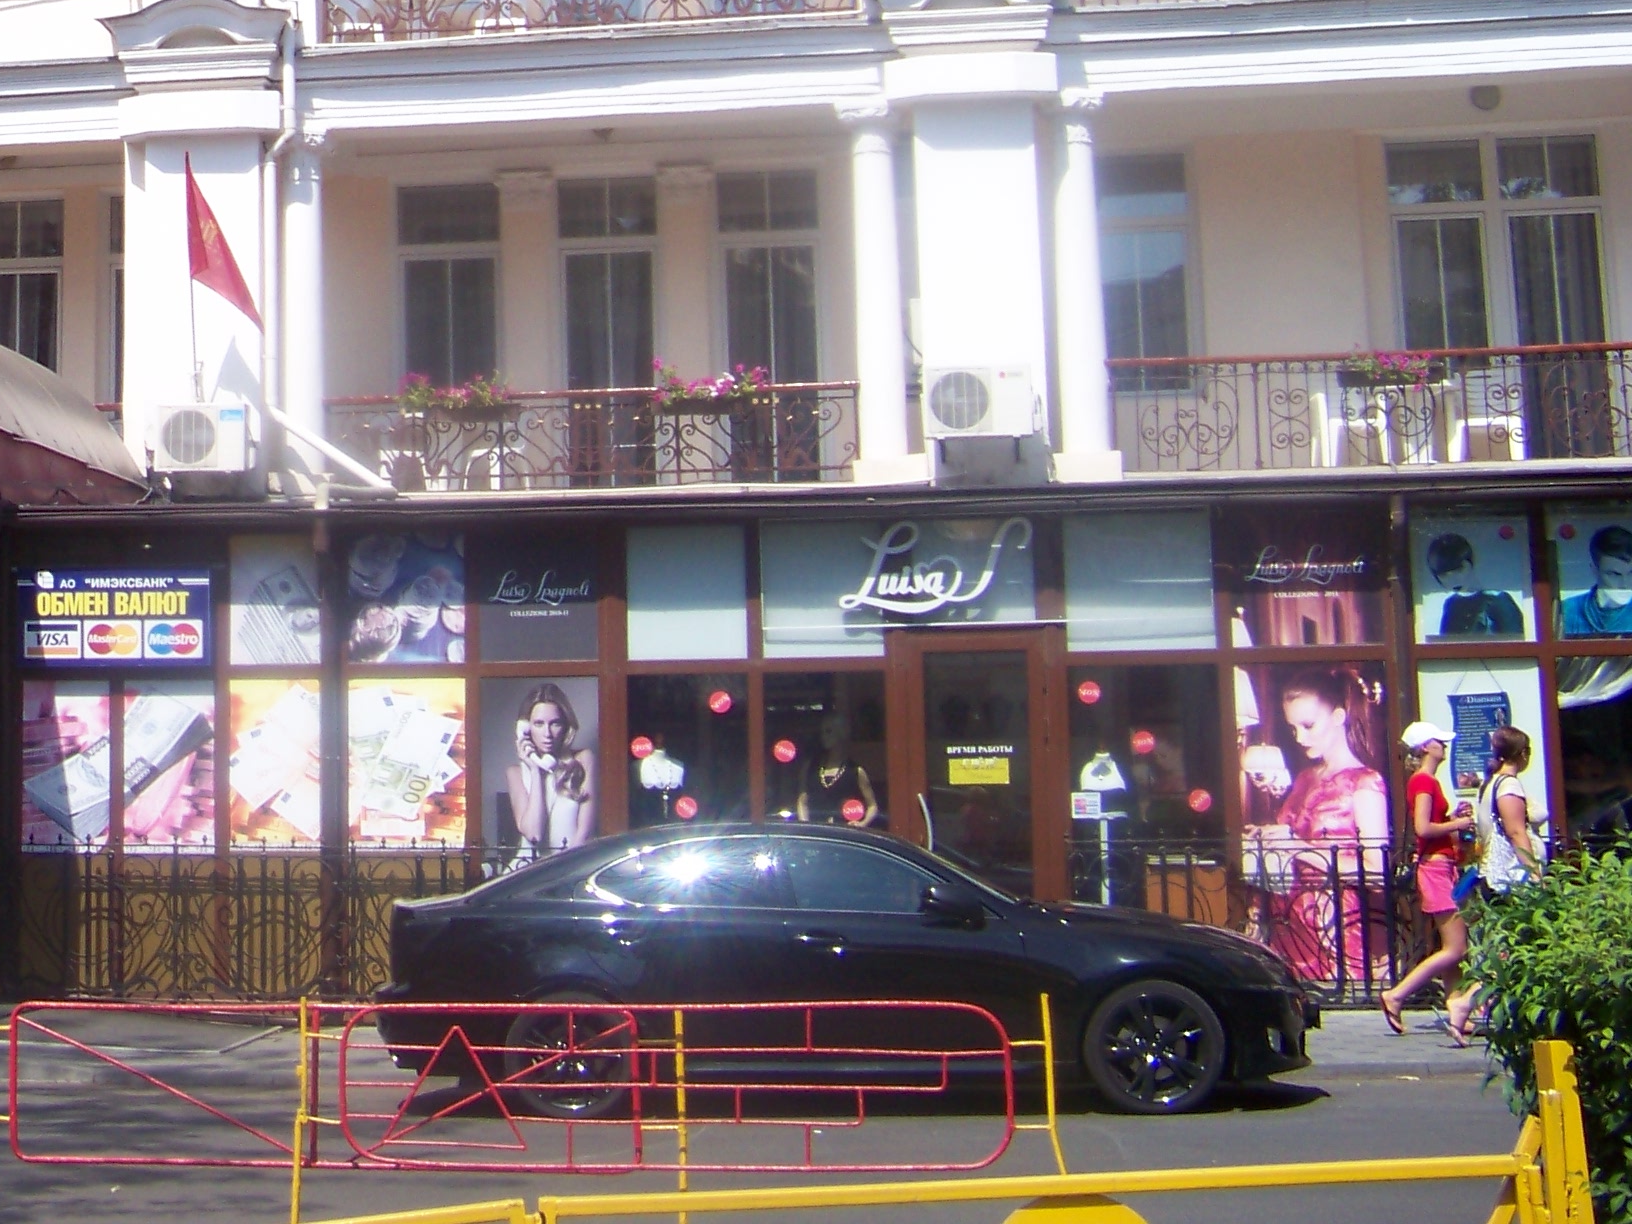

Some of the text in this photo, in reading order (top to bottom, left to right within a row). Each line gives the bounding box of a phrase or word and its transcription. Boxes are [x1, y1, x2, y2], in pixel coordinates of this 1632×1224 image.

[839, 521, 962, 614] Luisa
[1245, 545, 1295, 583] Luisa
[60, 579, 76, 588] АО
[489, 570, 531, 603] Luisa
[37, 591, 190, 616] ОБМЕН ВАЛЮТ
[37, 633, 69, 646] VISA
[88, 633, 138, 644] MasterCard
[148, 632, 200, 646] Maestro
[402, 774, 431, 804] 100
